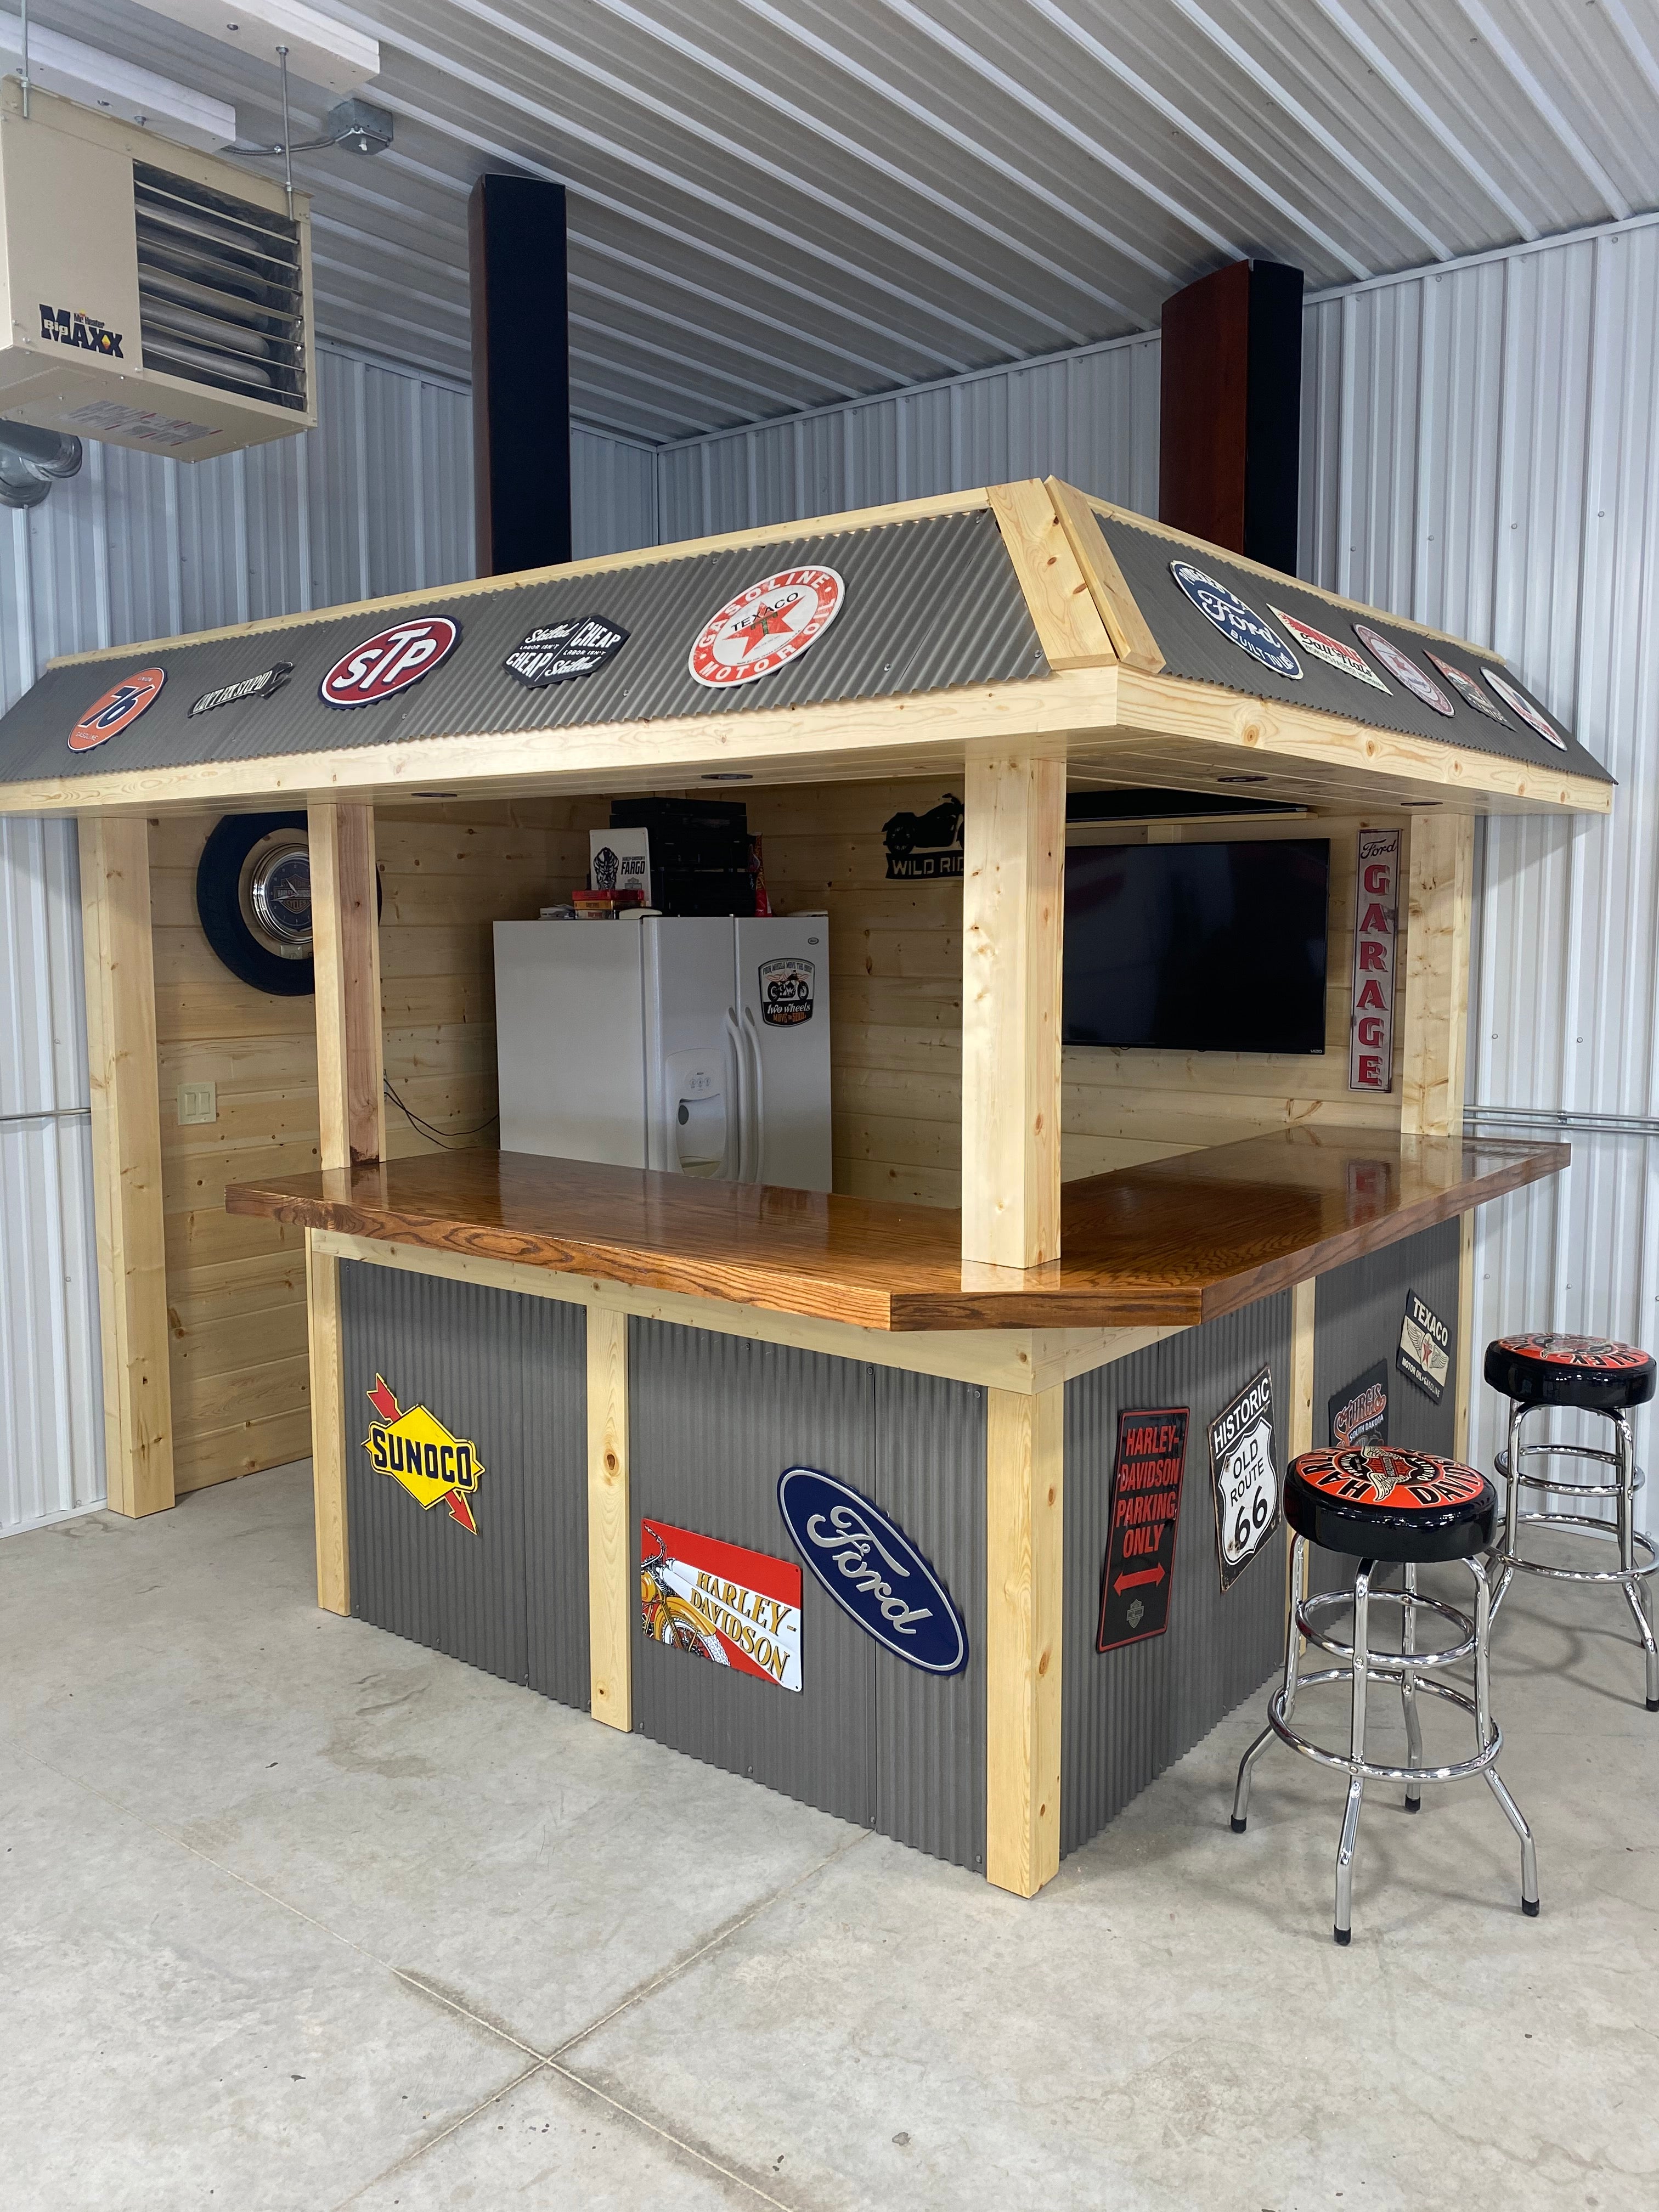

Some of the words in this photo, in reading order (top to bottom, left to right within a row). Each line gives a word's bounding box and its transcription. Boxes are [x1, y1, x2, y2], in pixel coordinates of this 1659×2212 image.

[39, 303, 124, 359] MAXX
[43, 319, 68, 335] Big
[85, 317, 105, 328] Heater
[698, 571, 831, 648] GASOLINE
[731, 592, 799, 631] TEXACO
[1198, 589, 1281, 648] Ford
[524, 623, 579, 644] Skilled
[570, 622, 621, 648] CHEAP
[699, 645, 797, 680] MOTOR
[802, 597, 836, 634] OIL
[1230, 629, 1266, 659] BUILT
[1265, 652, 1283, 668] TO
[331, 625, 438, 689] STP
[506, 652, 554, 678] CHEAP
[544, 656, 601, 677] Skilled
[77, 684, 155, 730] 76
[75, 731, 99, 741] GASOLINE
[620, 861, 645, 875] FARGO
[892, 859, 934, 875] WILD
[1361, 839, 1397, 860] Ford
[1356, 864, 1391, 1087] GARAGE
[767, 1004, 783, 1014] two
[784, 1002, 811, 1013] wheels
[773, 1013, 787, 1023] MOVE
[1413, 1296, 1449, 1347] TEXACO
[1402, 1357, 1417, 1375] MOTOR
[1423, 1376, 1441, 1398] GASOLINE
[1214, 1377, 1269, 1454] HISTORIC
[1334, 1383, 1384, 1434] STURGIS
[1349, 1424, 1365, 1442] SOUTH
[1365, 1414, 1384, 1433] DAKOTA
[372, 1427, 472, 1487] SUNOCO
[1126, 1425, 1180, 1457] HARLEY-
[1233, 1438, 1259, 1480] OLD
[1119, 1458, 1180, 1493] DAVIDSON
[1230, 1457, 1265, 1508] ROUTE
[1340, 1453, 1363, 1477] PREMIUM
[1407, 1457, 1436, 1481] QUALITY
[1115, 1491, 1177, 1528] PARKING
[1234, 1485, 1268, 1551] 66
[1122, 1523, 1165, 1559] ONLY
[806, 1505, 933, 1634] Ford
[696, 1571, 797, 1637] HARLEY-
[689, 1588, 791, 1682] DAVIDSON
